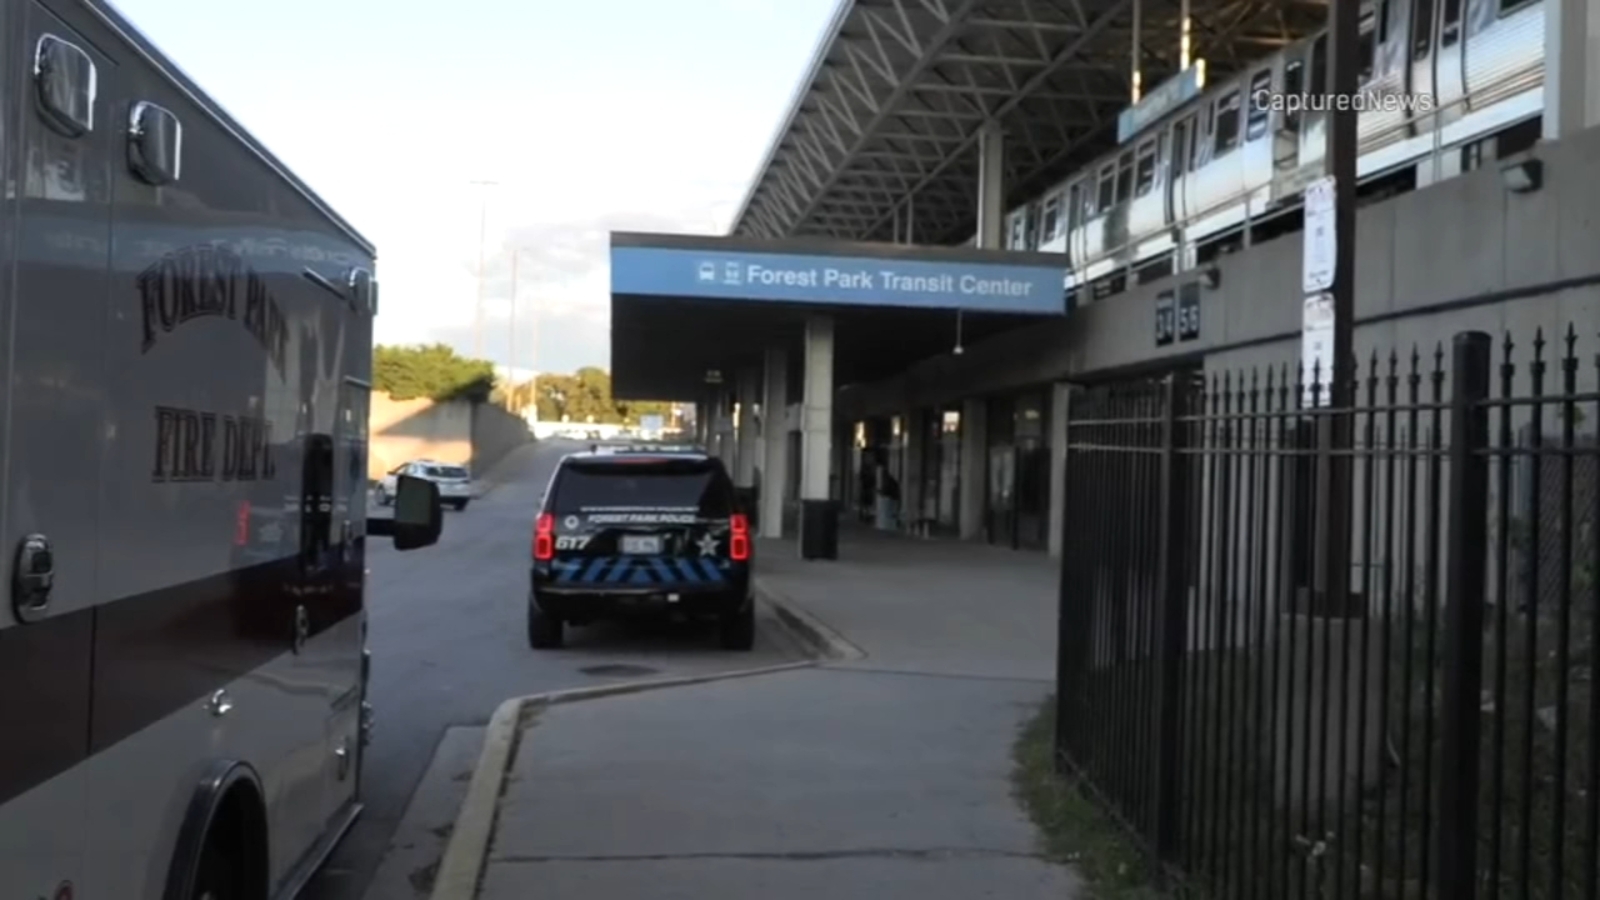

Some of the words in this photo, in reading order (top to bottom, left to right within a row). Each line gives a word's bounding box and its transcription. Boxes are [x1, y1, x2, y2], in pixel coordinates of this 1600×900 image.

[747, 264, 818, 288] Forest
[823, 268, 873, 291] Park
[880, 270, 954, 294] Transit
[959, 274, 1034, 298] Center
[152, 405, 217, 484] FIRE
[555, 534, 591, 551] 617
